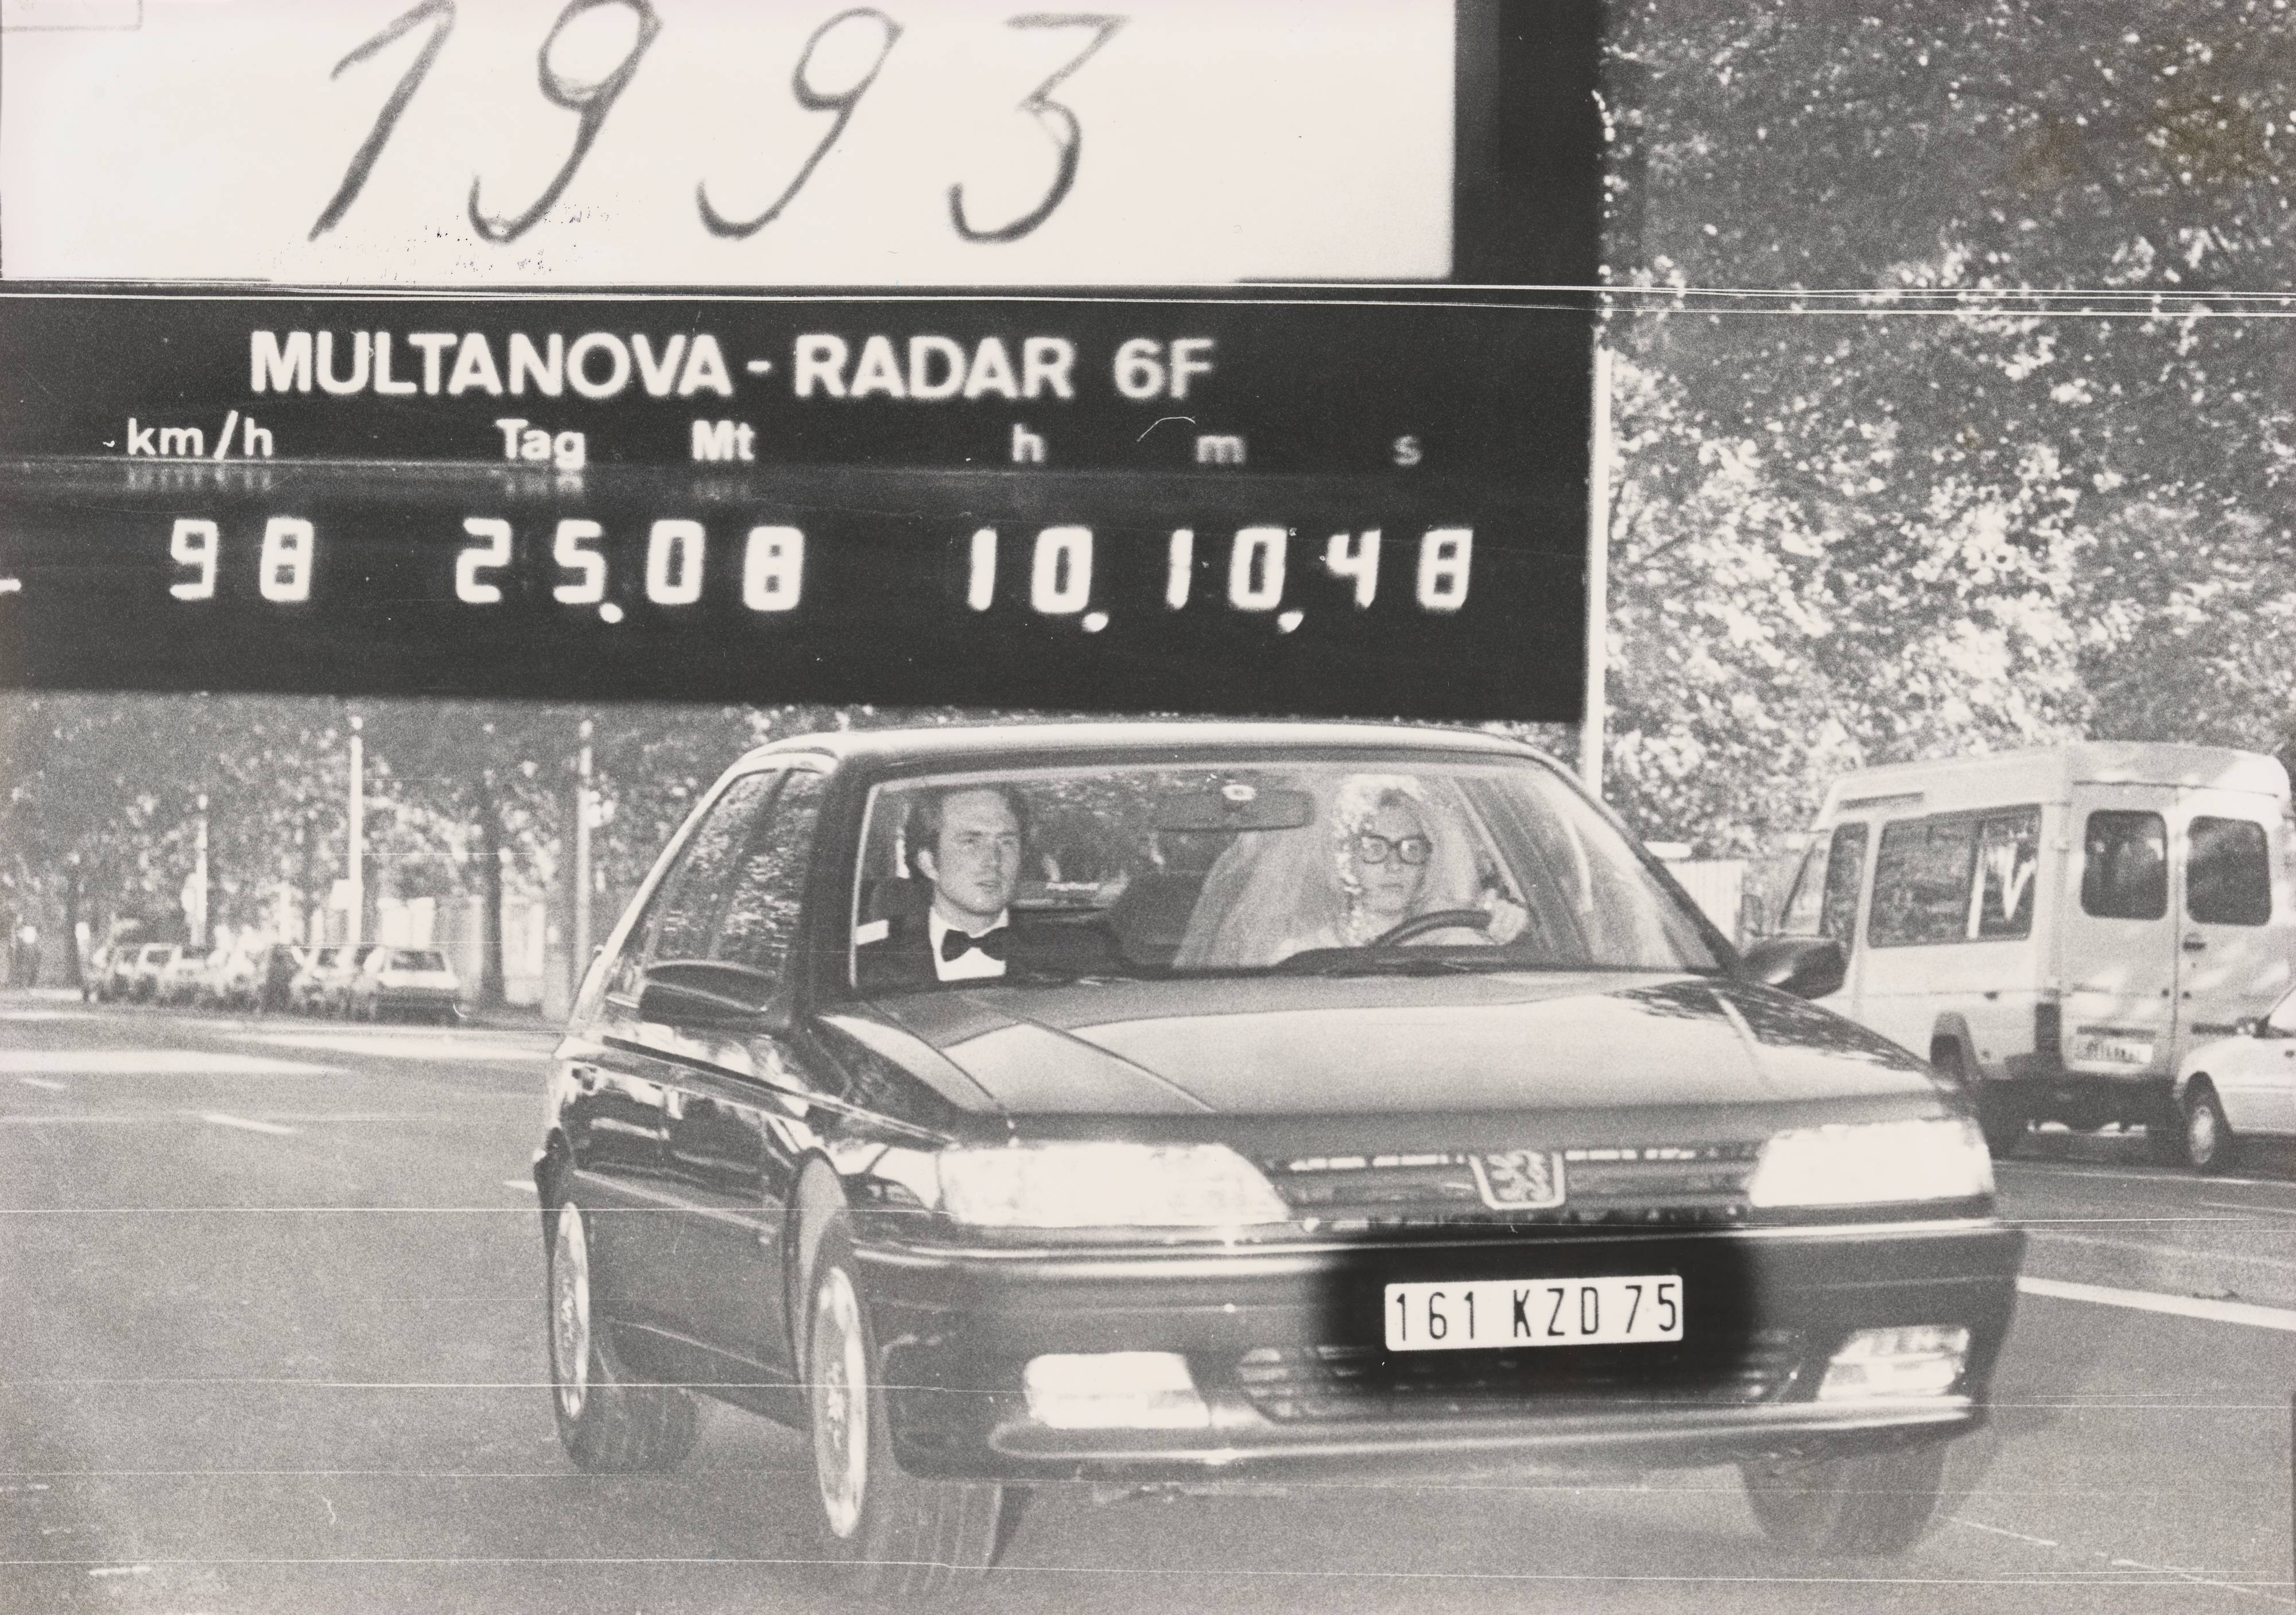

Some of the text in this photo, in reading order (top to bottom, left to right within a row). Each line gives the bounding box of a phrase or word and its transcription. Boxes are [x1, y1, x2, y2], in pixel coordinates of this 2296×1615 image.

[308, 0, 1131, 246] 1993
[249, 329, 735, 400] MULTANOVA
[792, 332, 1076, 401] RADAR
[1112, 337, 1216, 401] 6F
[123, 409, 275, 460] km/h
[494, 417, 587, 469] Tag
[691, 418, 756, 460] Mt
[1011, 421, 1046, 463] h
[1195, 434, 1247, 463] m
[1393, 434, 1422, 465] s
[168, 515, 316, 604] 98
[1395, 1283, 1677, 1341] 161 KZD 75
